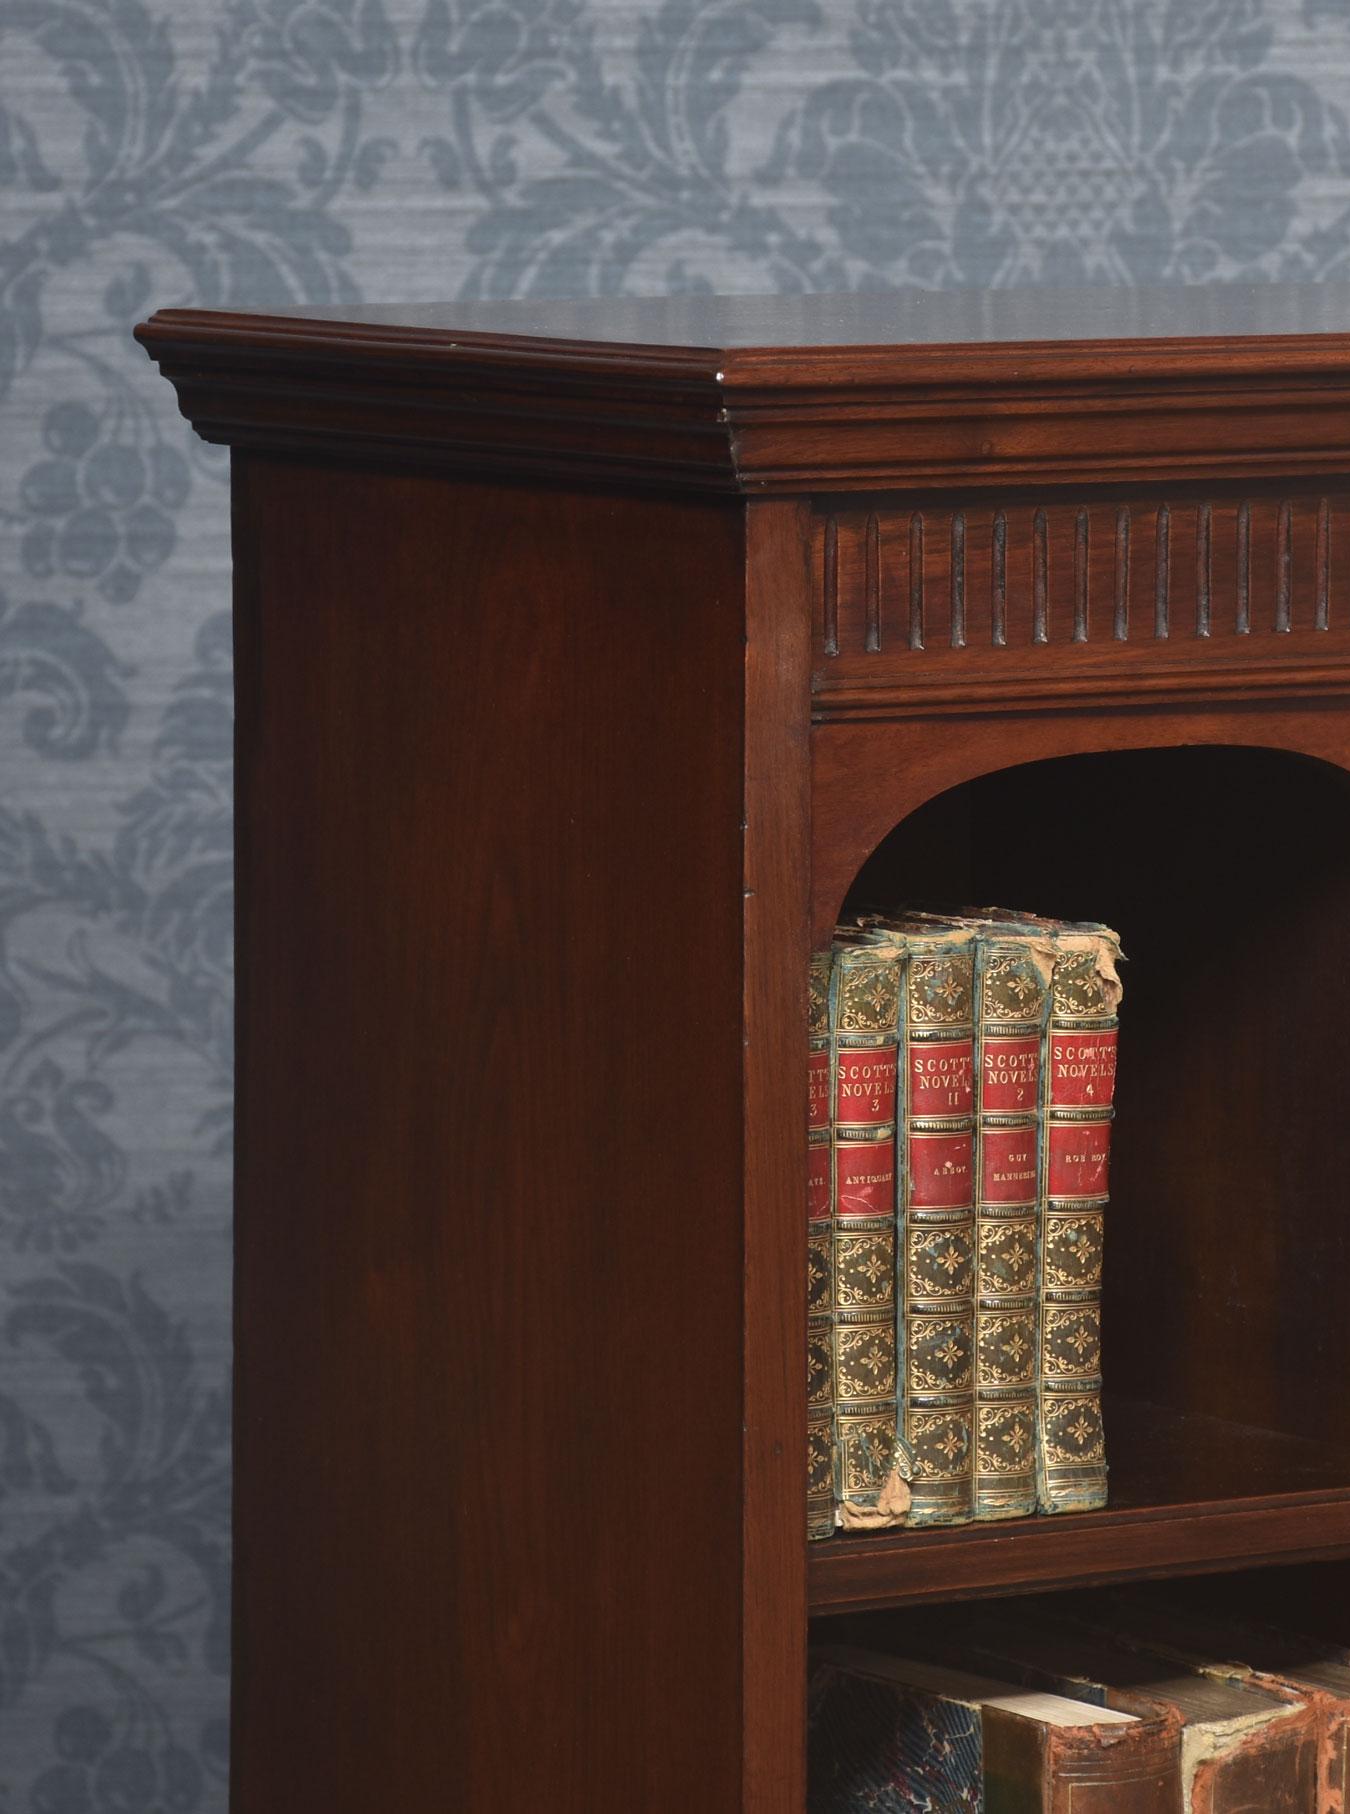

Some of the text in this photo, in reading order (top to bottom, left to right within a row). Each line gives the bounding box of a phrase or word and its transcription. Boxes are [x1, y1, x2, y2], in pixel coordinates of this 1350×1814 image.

[1057, 1063, 1115, 1078] NOVELS
[1017, 1088, 1025, 1101] 2
[1086, 1083, 1095, 1097] 4
[871, 1098, 880, 1112] 3
